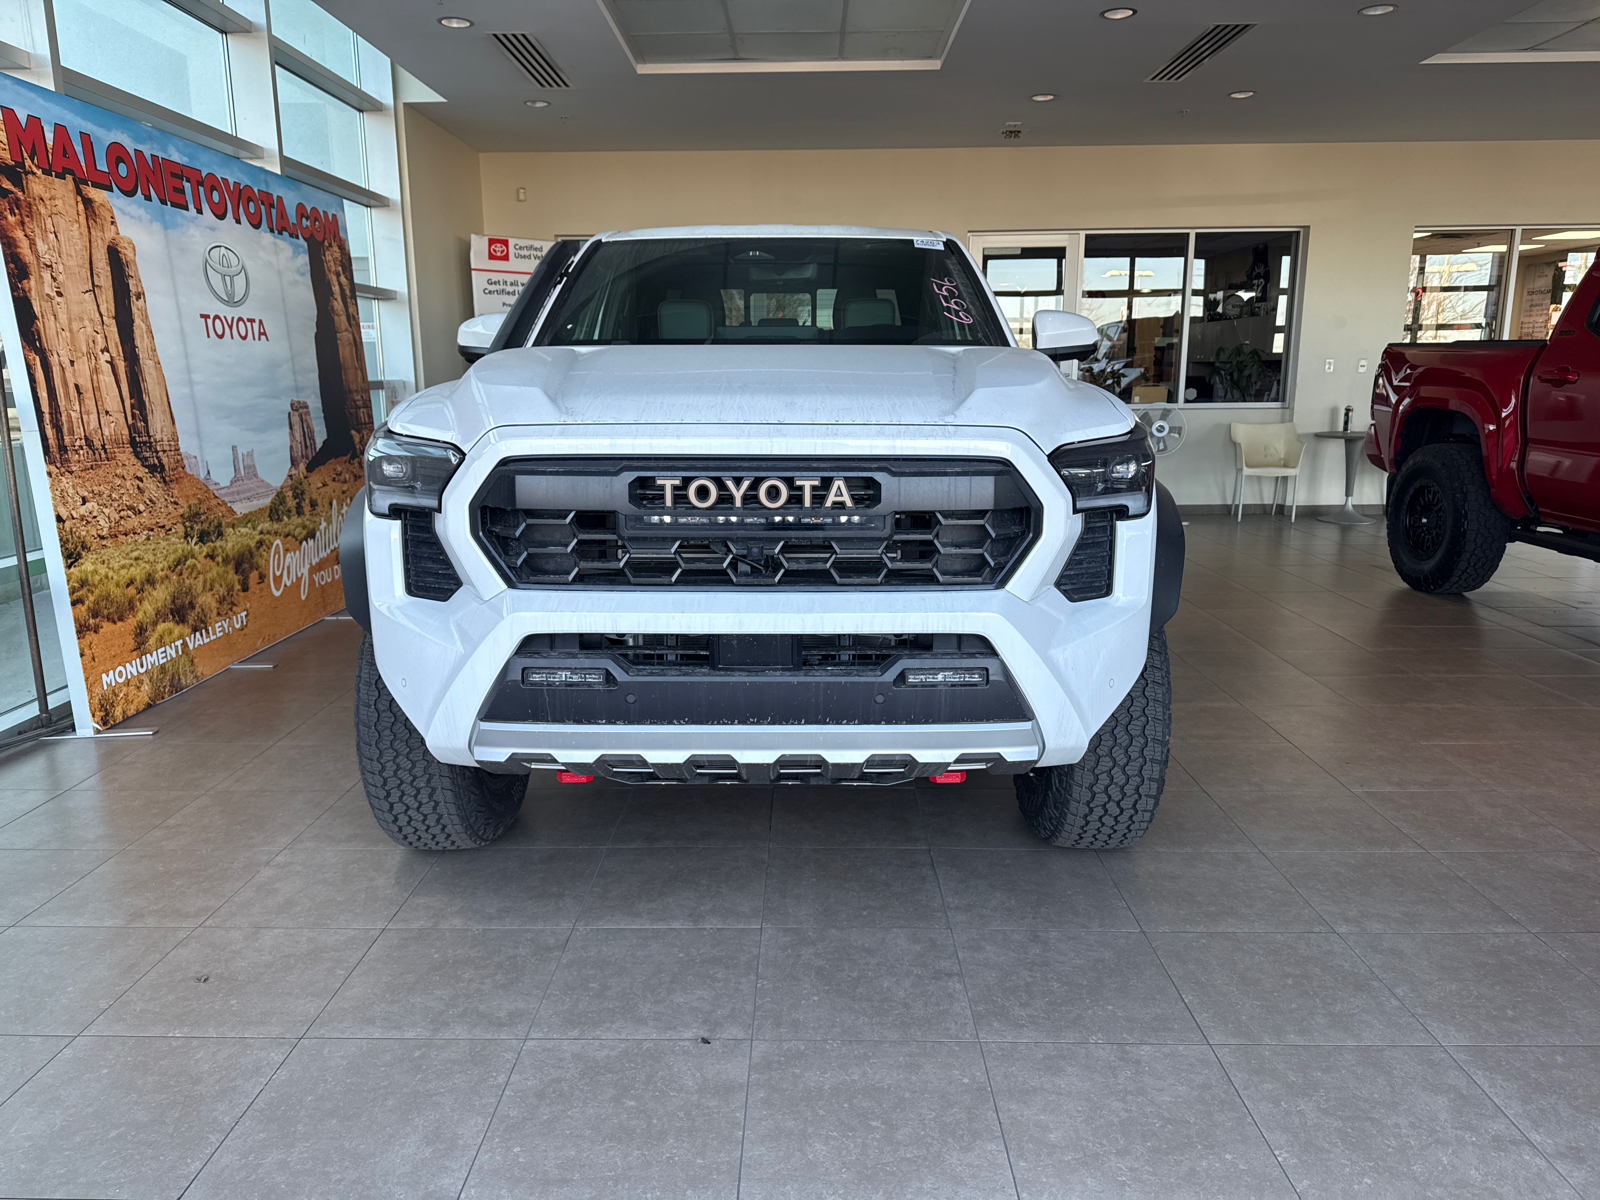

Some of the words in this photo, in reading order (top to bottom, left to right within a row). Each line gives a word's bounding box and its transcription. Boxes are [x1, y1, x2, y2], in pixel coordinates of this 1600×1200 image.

[0, 105, 342, 246] MALONETOYOTA.COM
[513, 243, 543, 253] Certified
[514, 252, 531, 260] Used
[483, 287, 516, 297] Certified
[487, 278, 500, 287] Get
[502, 279, 508, 287] it
[930, 277, 973, 324] 6556
[199, 313, 270, 342] TOYOTA
[655, 476, 856, 509] TOYOTA
[312, 567, 332, 587] YOU
[101, 639, 184, 690] MONUMENT
[185, 618, 233, 650] VALLEY,
[233, 611, 248, 629] UT
